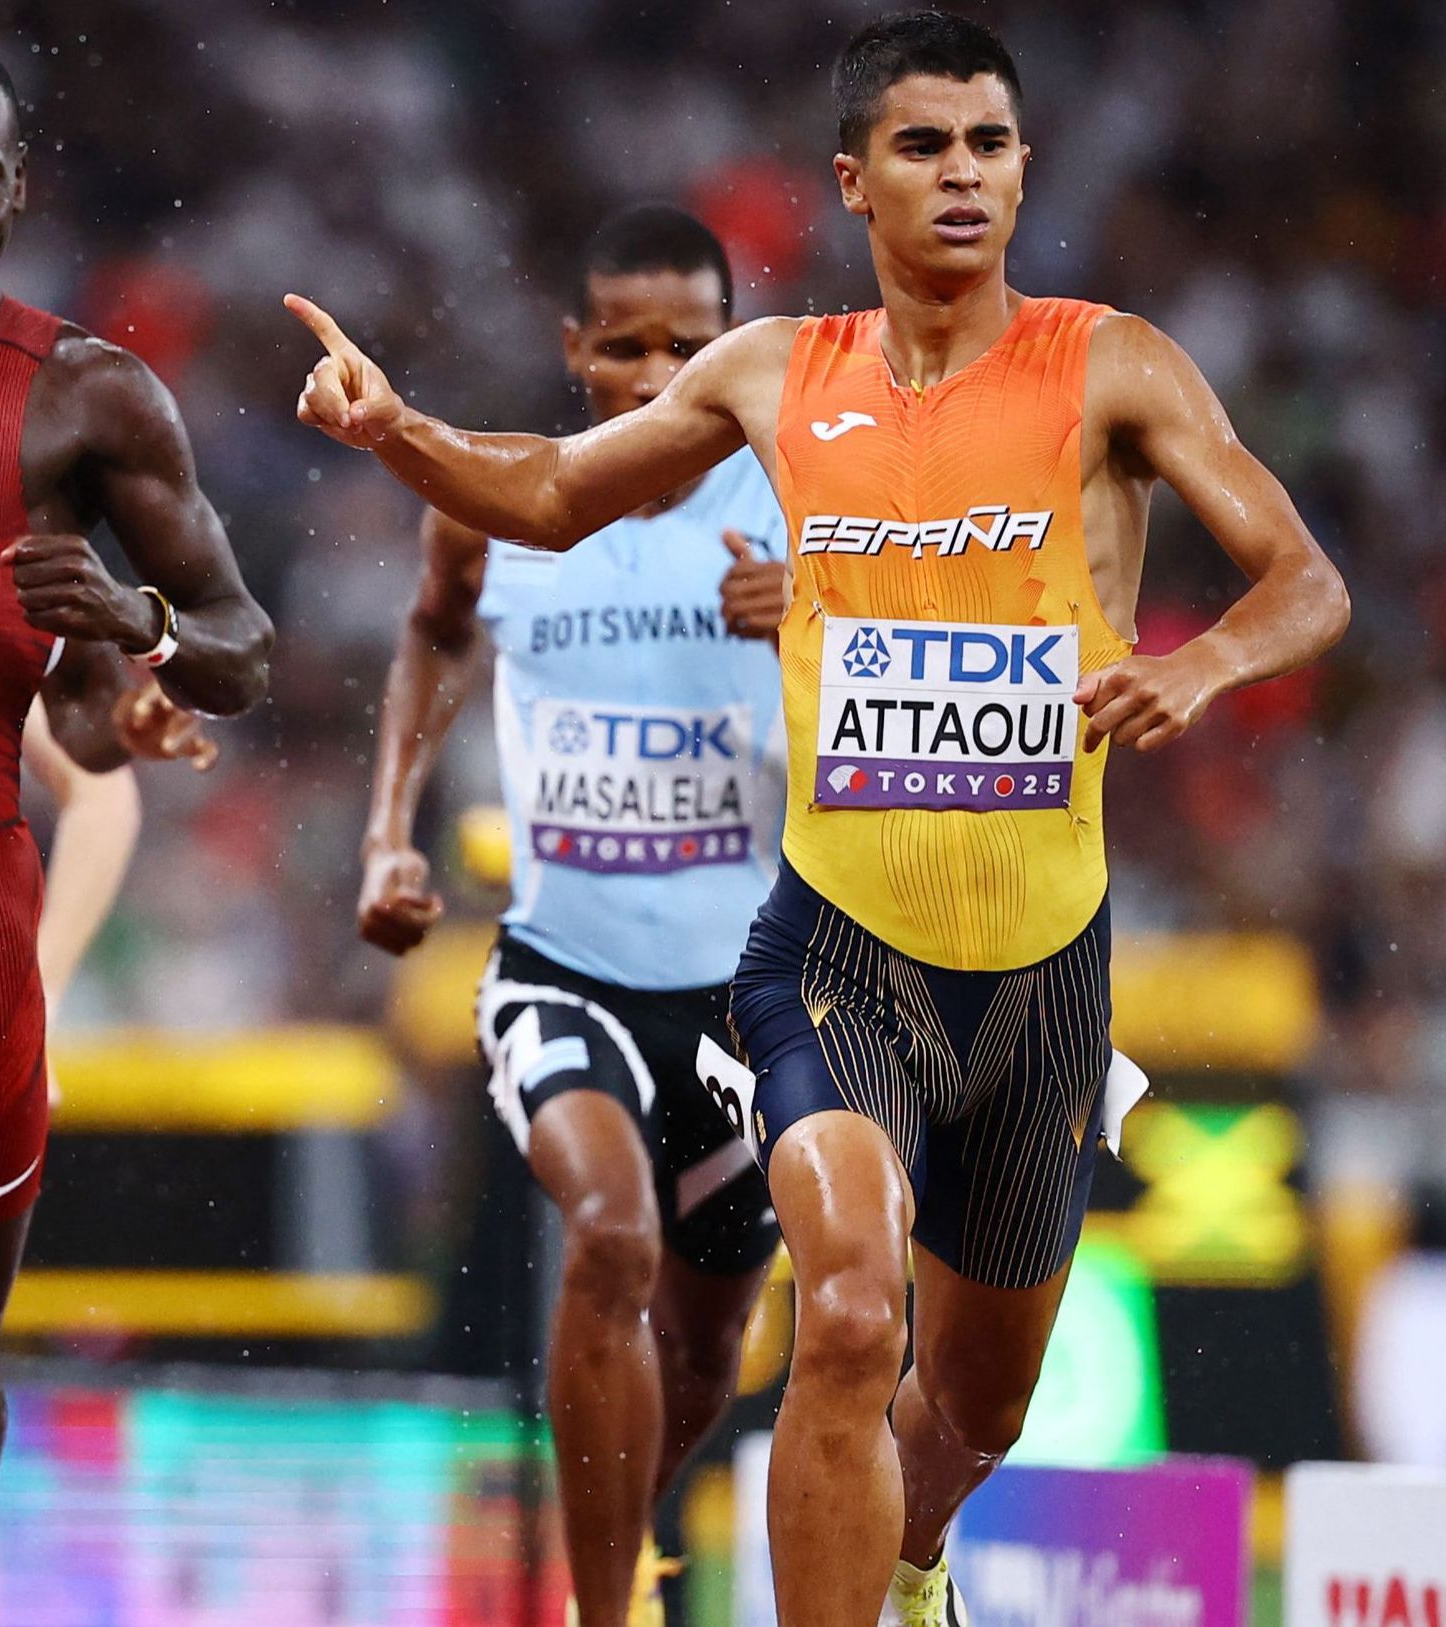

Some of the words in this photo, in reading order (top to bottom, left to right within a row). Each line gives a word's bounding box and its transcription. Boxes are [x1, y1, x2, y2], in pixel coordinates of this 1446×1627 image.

[797, 505, 1054, 559] ESPAÑA
[530, 603, 747, 653] BOTSWAN
[891, 628, 1065, 685] TDK
[592, 713, 738, 760] TDK
[830, 698, 1066, 757] ATTAOUI
[535, 770, 743, 822] MASALELA
